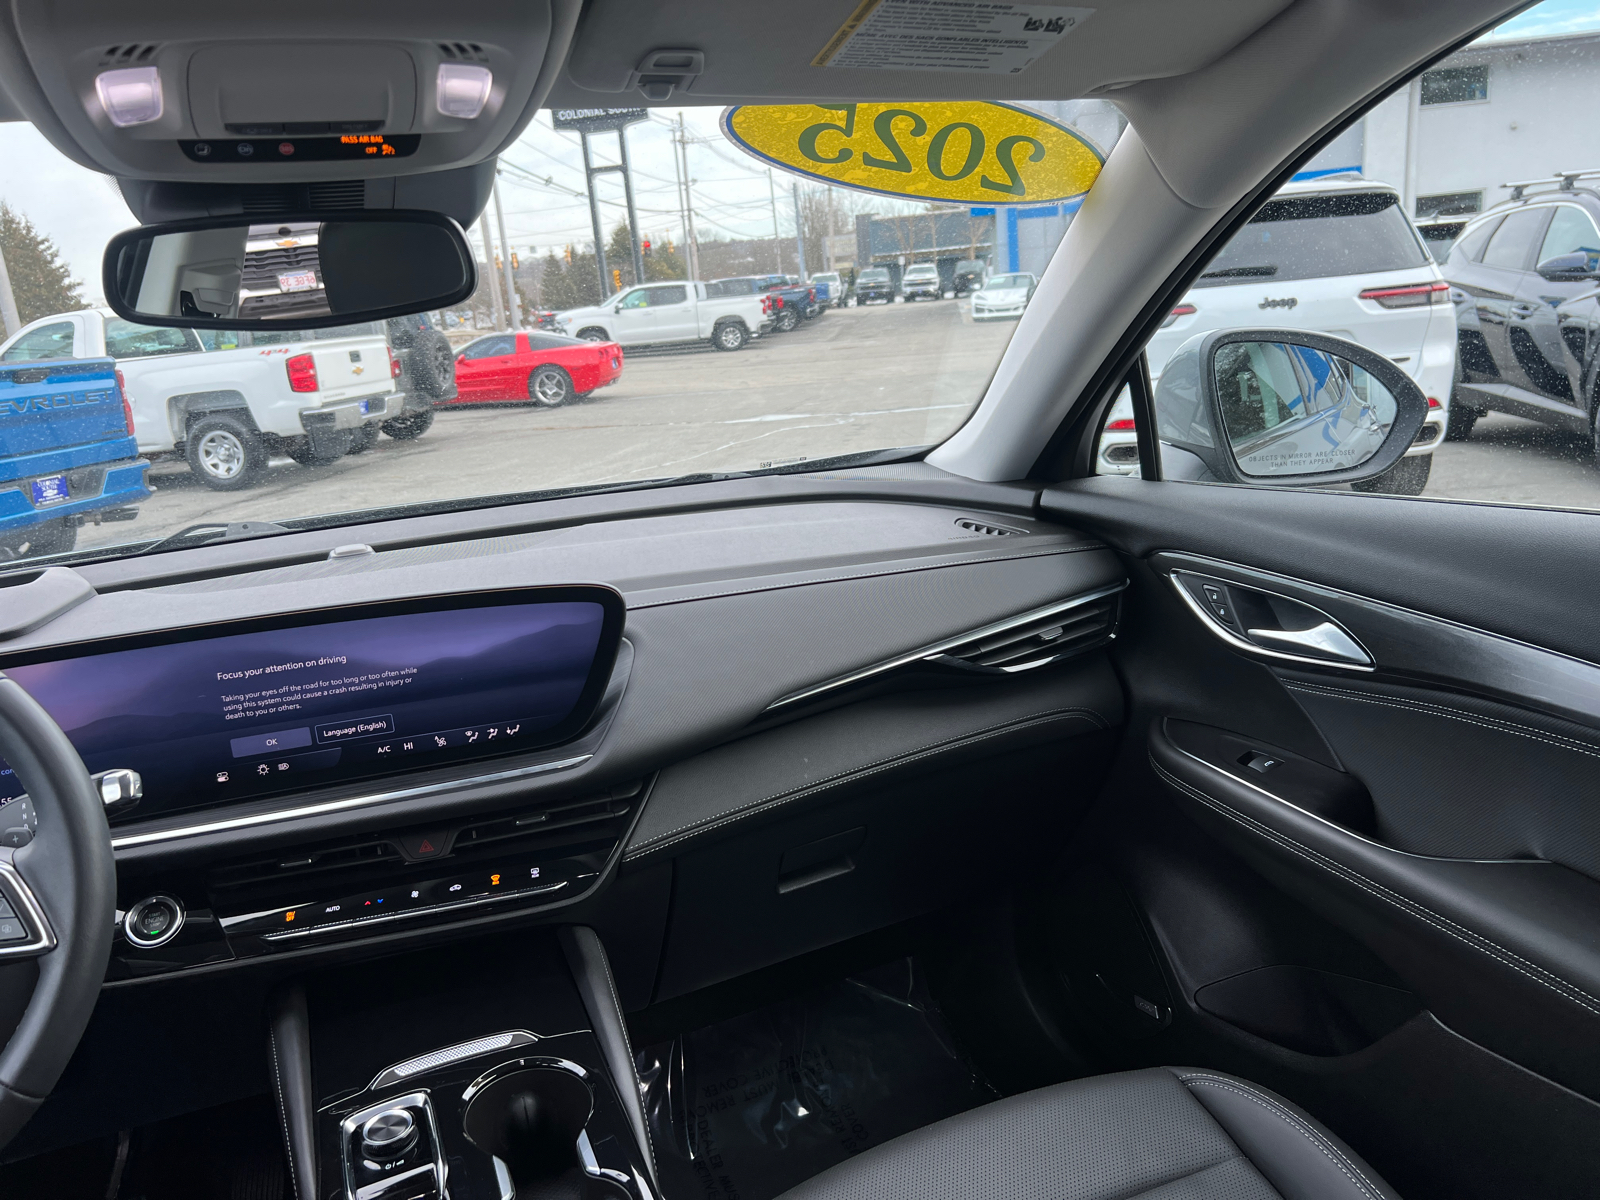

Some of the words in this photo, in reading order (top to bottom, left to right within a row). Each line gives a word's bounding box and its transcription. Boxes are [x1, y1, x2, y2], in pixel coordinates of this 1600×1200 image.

[558, 108, 606, 120] COLONIAL
[341, 135, 358, 144] PASS
[359, 135, 370, 143] AIR
[1258, 297, 1298, 310] Jeep
[217, 670, 243, 680] Focus
[245, 668, 263, 678] your
[265, 661, 304, 674] attention
[318, 655, 347, 666] driving
[221, 694, 244, 702] Taking
[245, 692, 260, 701] your
[262, 689, 278, 698] eyes
[278, 686, 289, 694] off
[303, 682, 318, 690] road
[223, 703, 242, 711] using
[243, 700, 256, 709] this
[258, 697, 281, 707] system
[283, 694, 301, 702] could
[329, 686, 347, 694] crash
[349, 682, 377, 692] resulting
[386, 678, 404, 687] injury
[225, 712, 245, 720] death
[255, 708, 267, 717] you
[278, 703, 302, 712] others.
[324, 726, 356, 737] Language
[358, 721, 387, 733] (English)
[377, 746, 391, 754] A/C
[403, 742, 414, 750] HI
[702, 1074, 748, 1098] COVER
